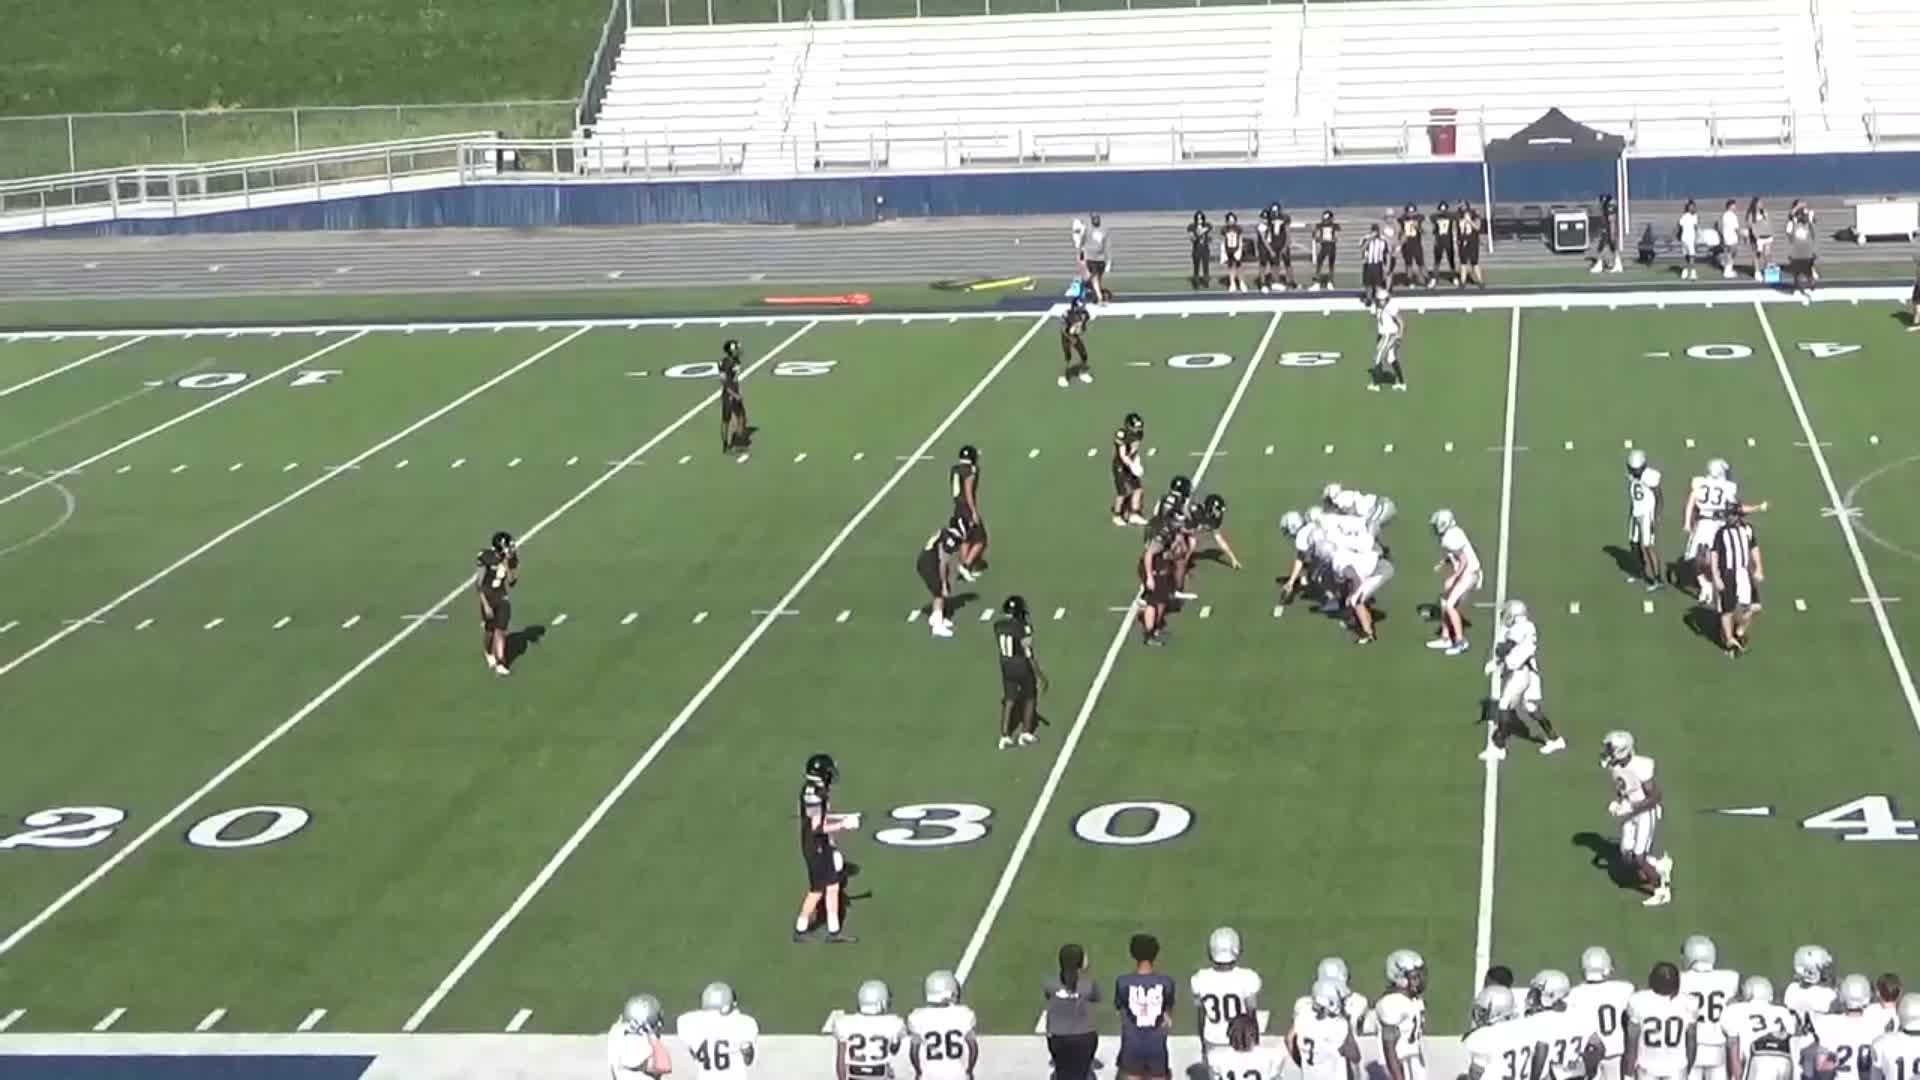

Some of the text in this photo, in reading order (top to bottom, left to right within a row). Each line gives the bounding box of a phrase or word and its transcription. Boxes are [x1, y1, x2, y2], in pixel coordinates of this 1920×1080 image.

[1633, 482, 1645, 502] 6
[1699, 484, 1725, 506] 33
[1202, 993, 1241, 1024] 30
[1598, 1004, 1617, 1037] 0
[848, 1034, 888, 1062] 23
[924, 1029, 963, 1060] 26
[1643, 1016, 1684, 1049] 20
[696, 1039, 730, 1070] 46
